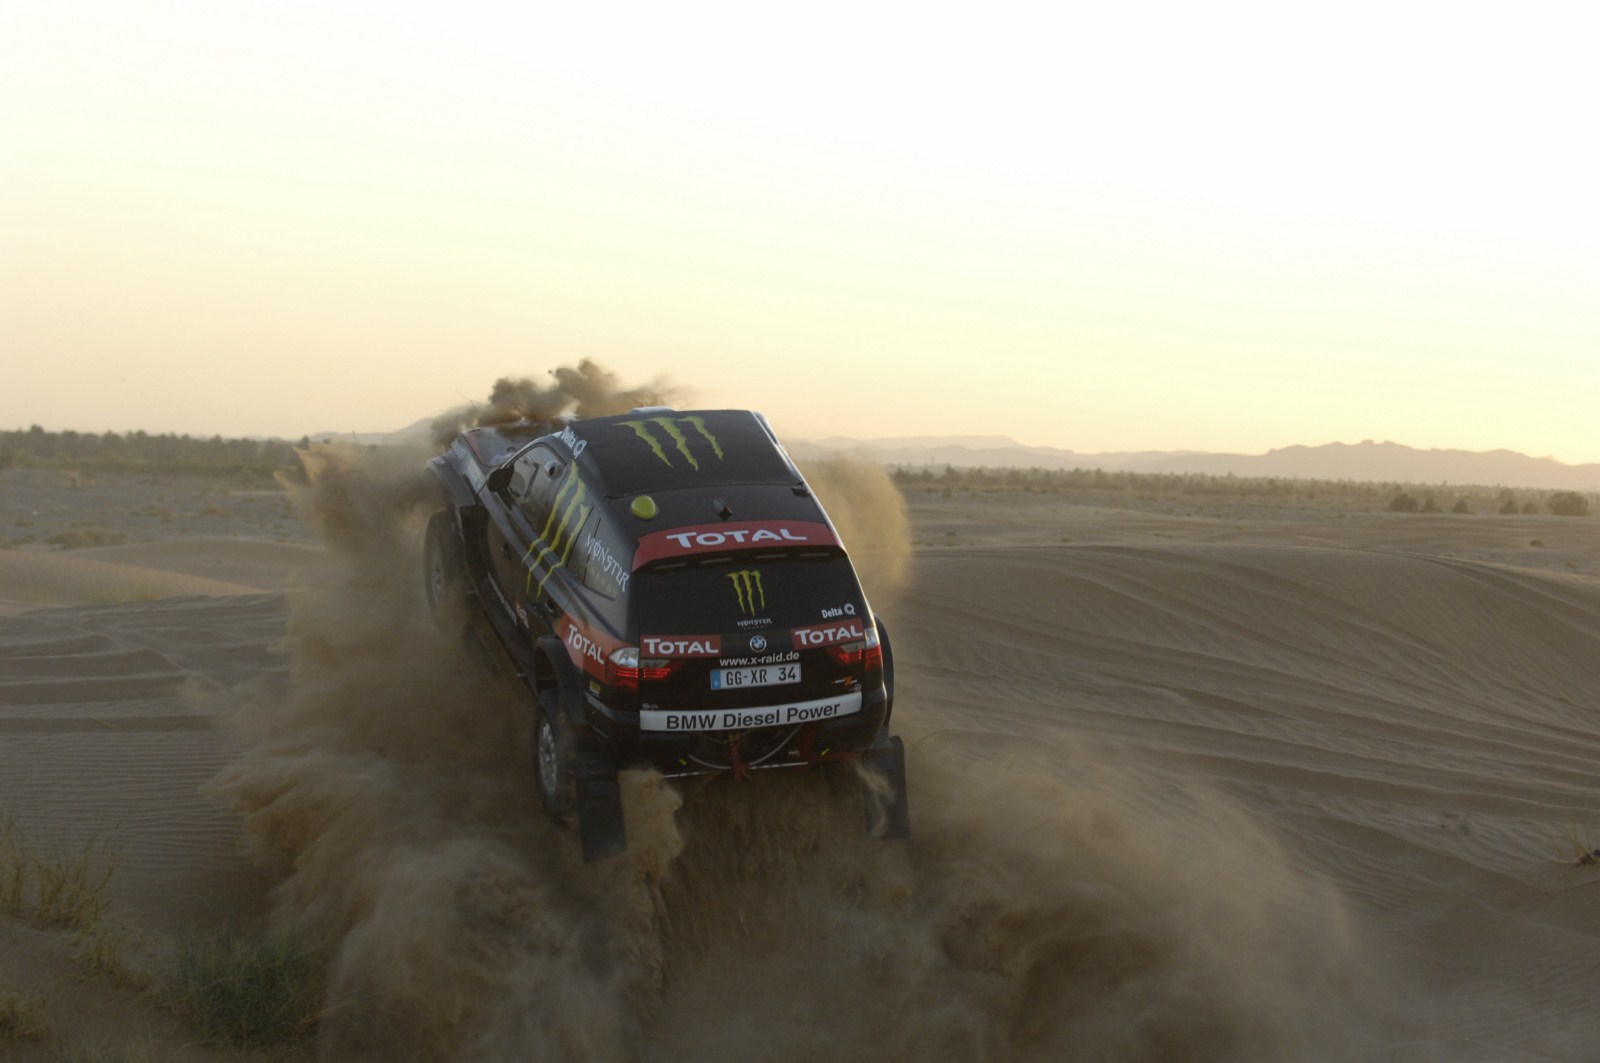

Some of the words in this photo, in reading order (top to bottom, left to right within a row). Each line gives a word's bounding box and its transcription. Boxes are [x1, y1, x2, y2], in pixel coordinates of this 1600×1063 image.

[666, 528, 807, 548] TOTAL
[821, 608, 843, 619] Delta
[844, 603, 856, 616] Q
[568, 623, 605, 665] TOTAL
[795, 624, 863, 646] TOTAL
[643, 638, 719, 655] TOTAL
[719, 651, 800, 667] www.x-raid.de
[778, 667, 797, 682] 34
[666, 714, 717, 730] BMW
[723, 709, 780, 729] Diesel
[786, 702, 841, 722] Power
